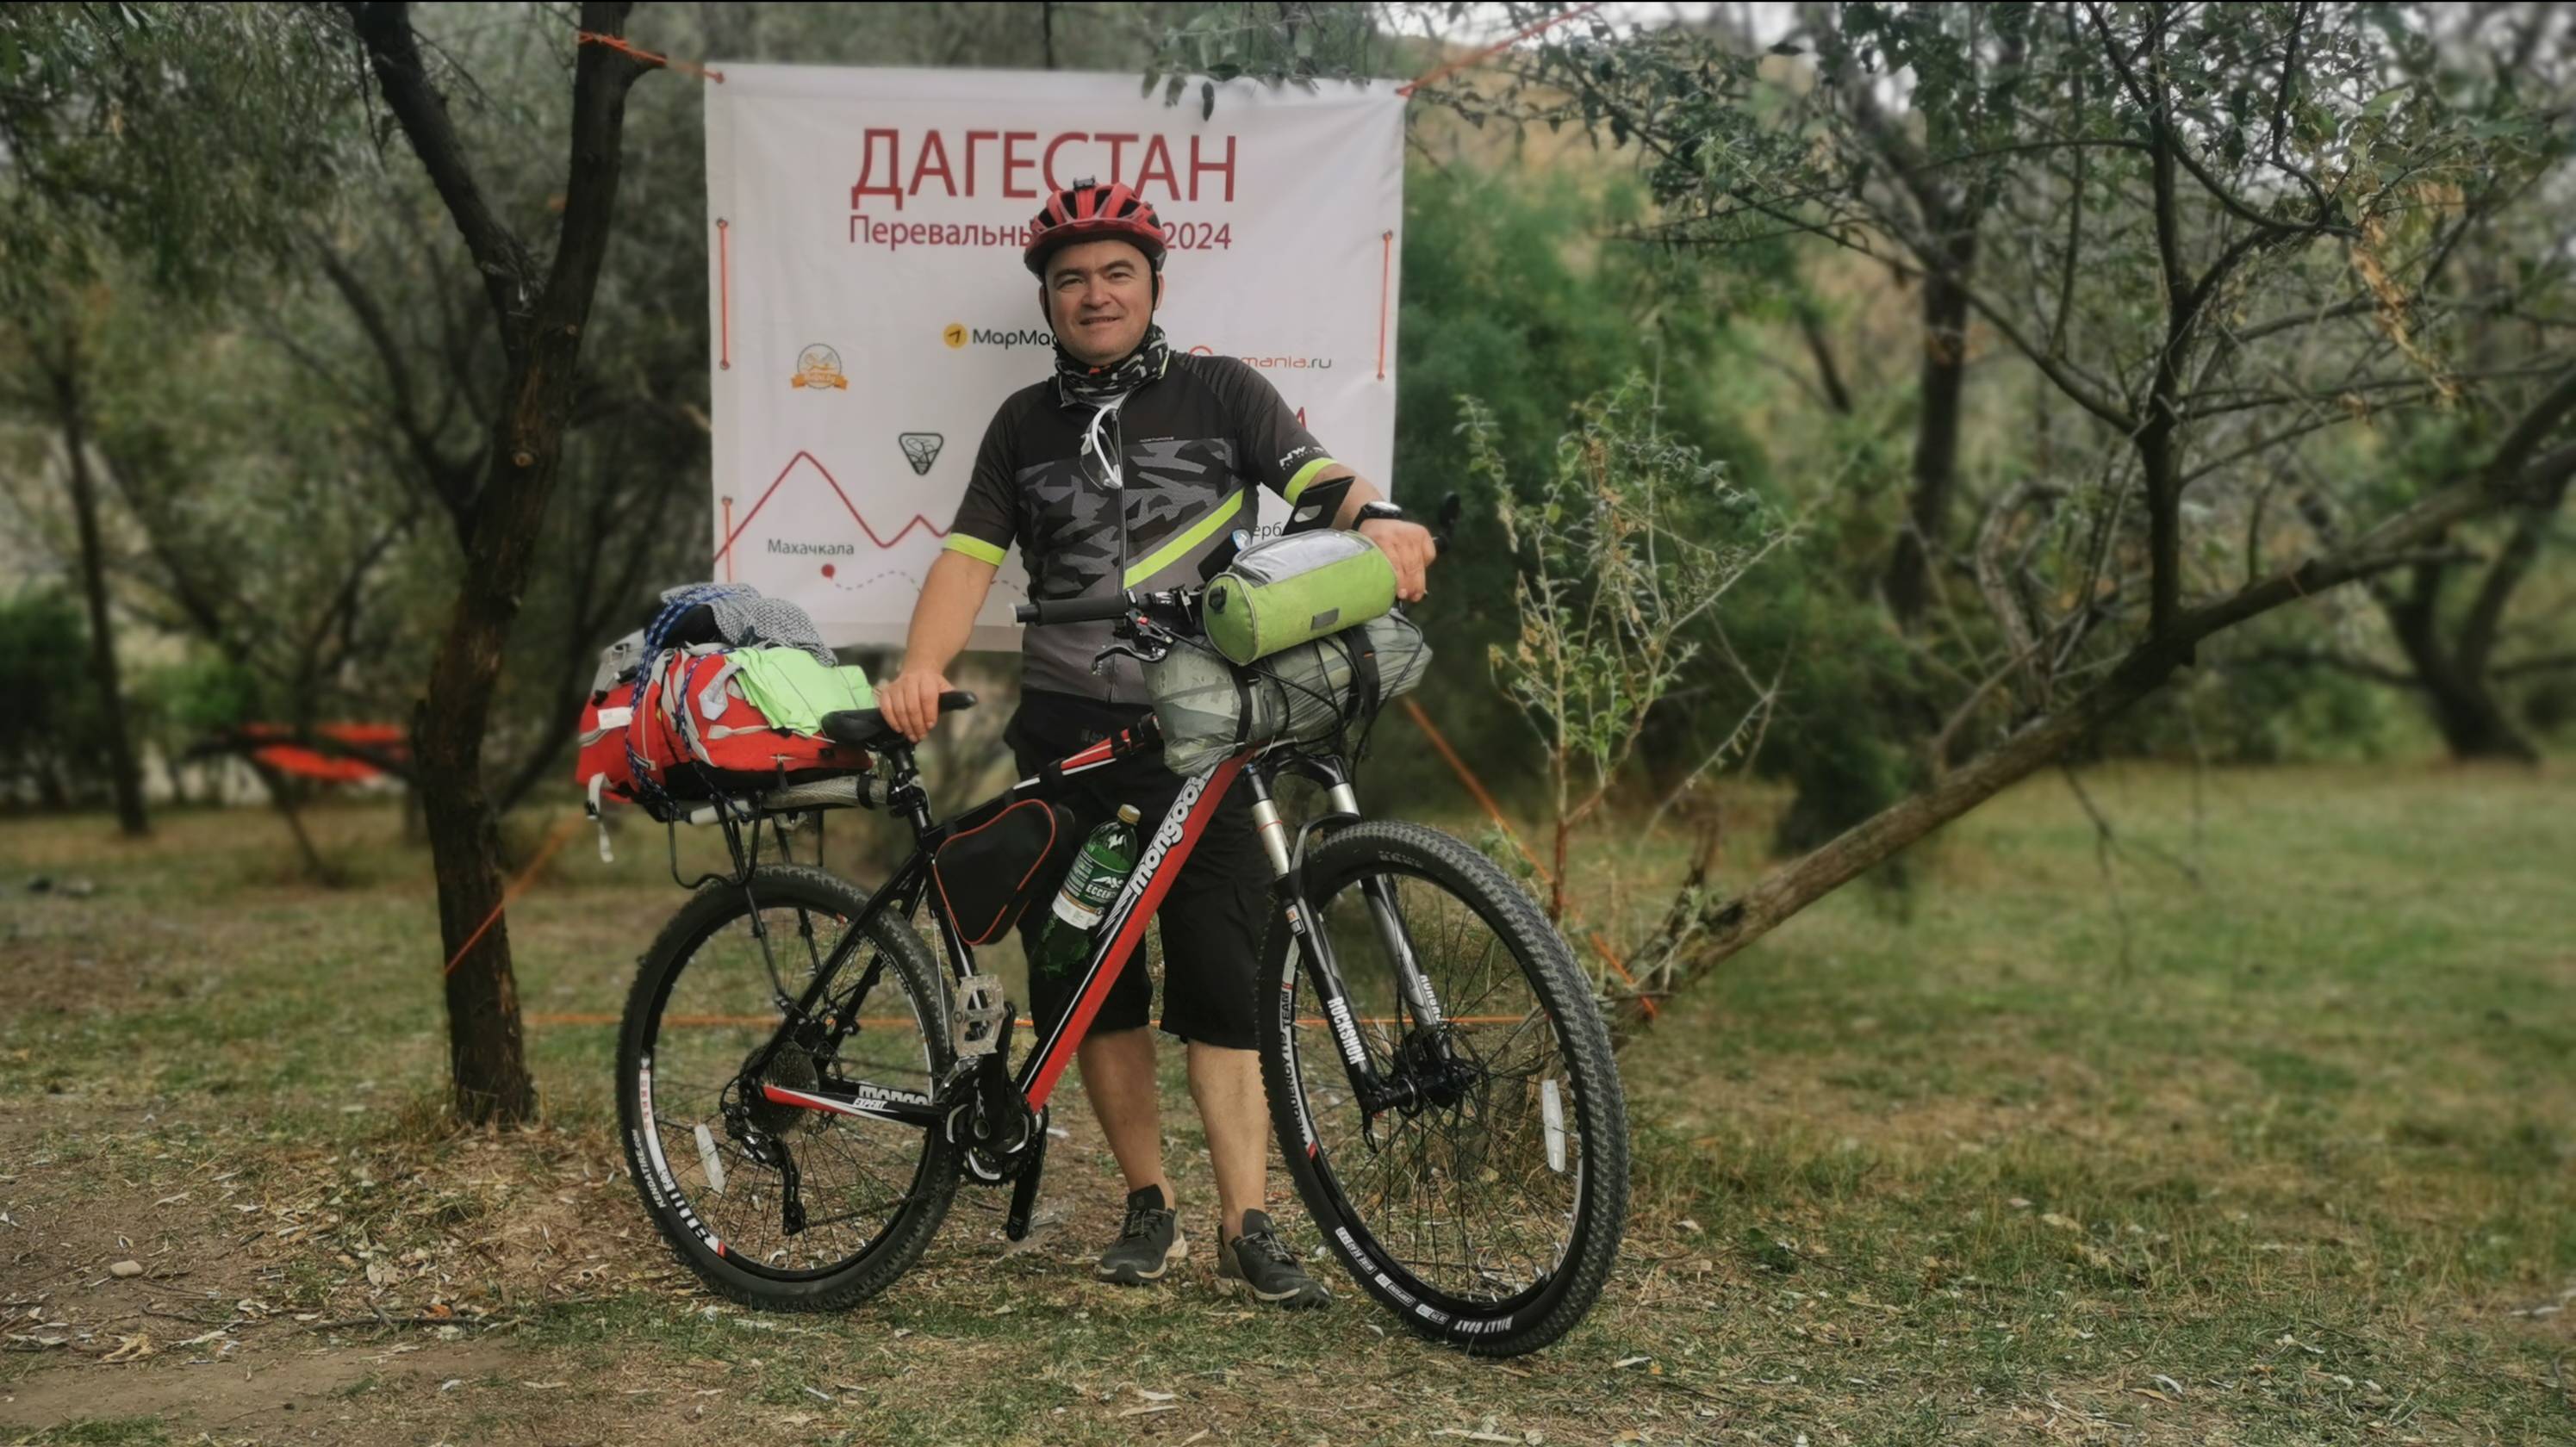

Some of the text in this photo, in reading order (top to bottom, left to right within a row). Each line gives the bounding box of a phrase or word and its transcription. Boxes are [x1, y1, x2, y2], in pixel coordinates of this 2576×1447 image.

[851, 128, 1236, 211] ДАГЕСТАН
[849, 215, 1232, 251] Перевальны 2024
[973, 328, 1056, 350] MapMa
[1241, 356, 1332, 369] mania.ru
[768, 538, 855, 556] Махачкала
[1129, 776, 1206, 896] mongoos
[1327, 997, 1366, 1065] ROCKSHOX
